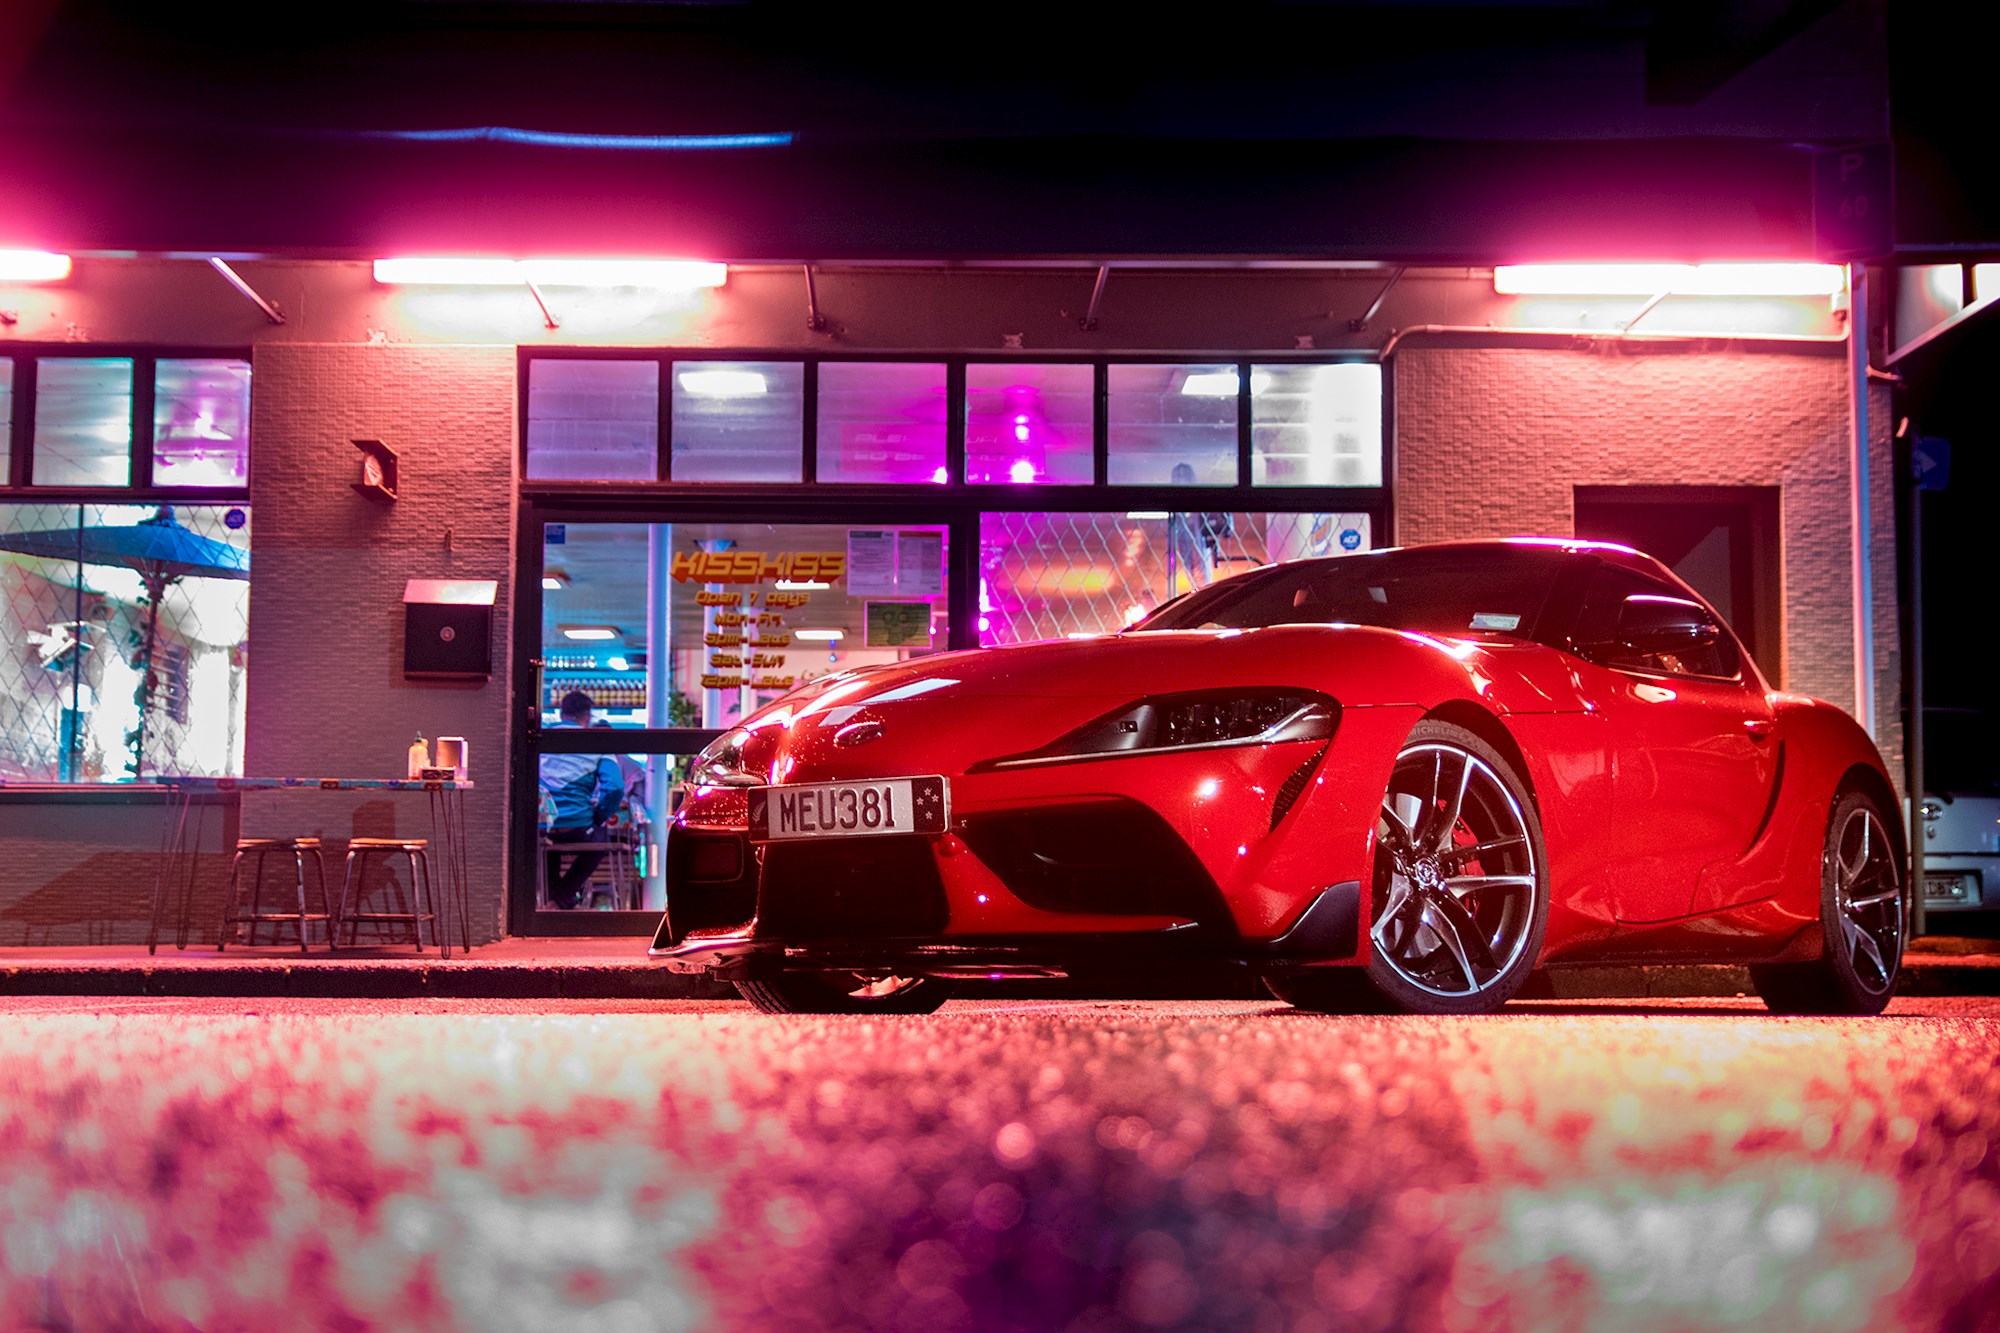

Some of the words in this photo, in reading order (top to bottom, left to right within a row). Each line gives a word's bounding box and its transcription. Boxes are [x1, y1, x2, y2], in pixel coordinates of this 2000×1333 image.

[670, 551, 846, 584] KISSKISS
[695, 591, 742, 607] Open
[749, 591, 759, 606] 7
[765, 592, 811, 609] days
[780, 786, 895, 832] MEU381
